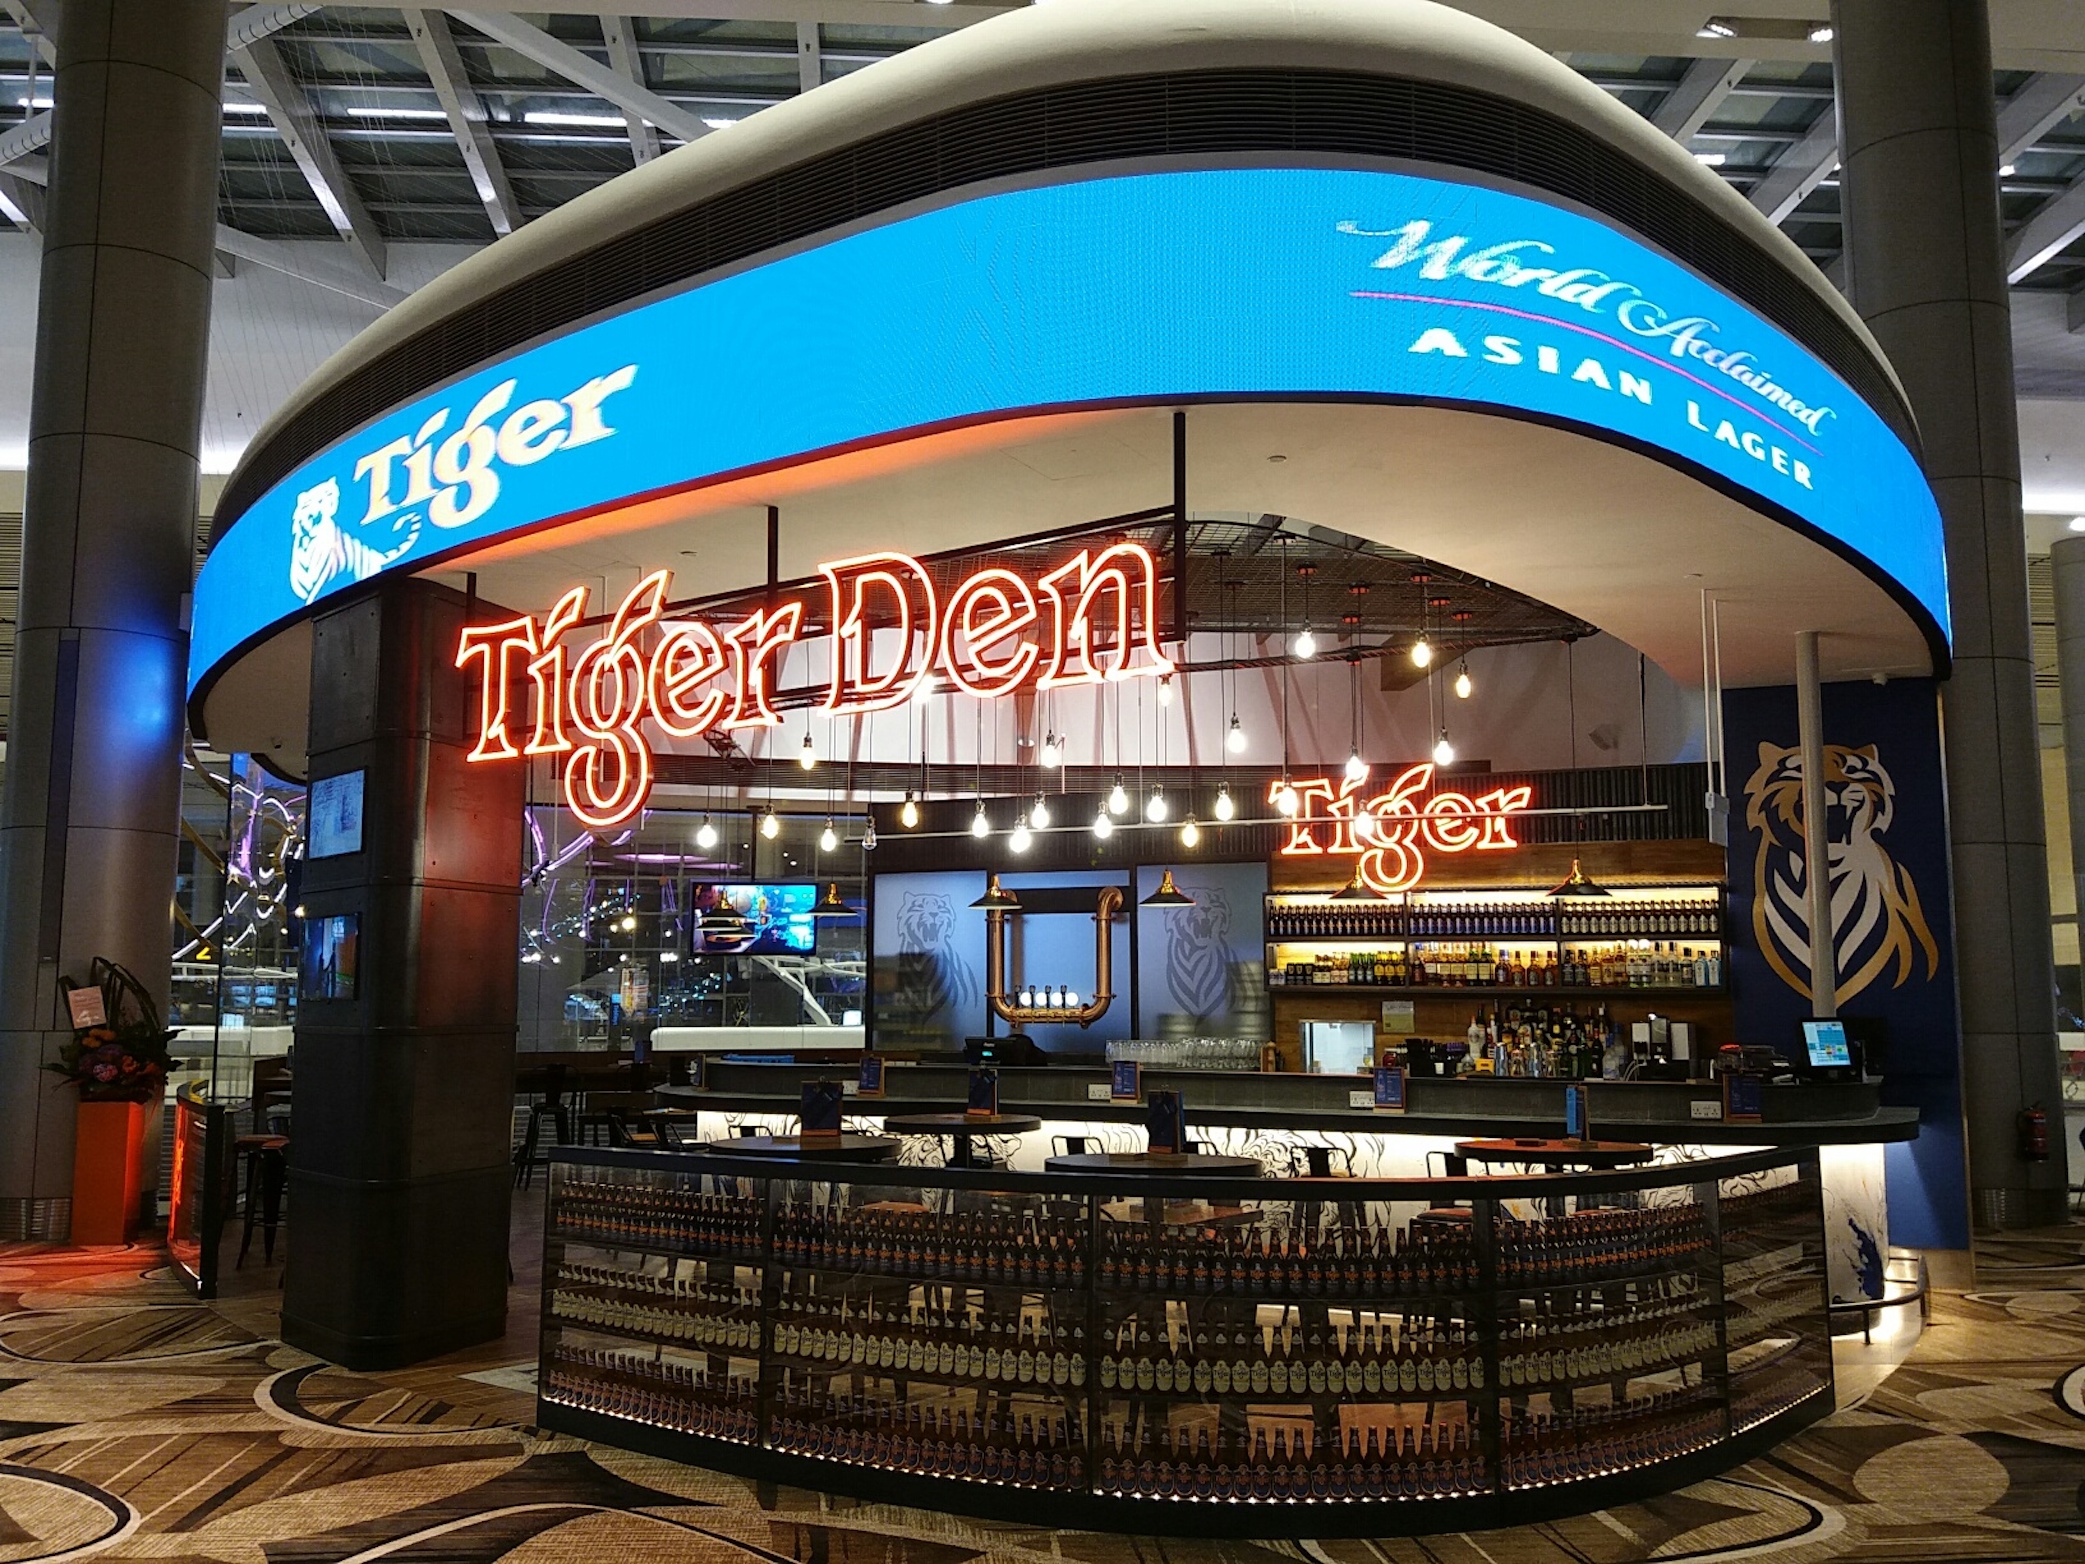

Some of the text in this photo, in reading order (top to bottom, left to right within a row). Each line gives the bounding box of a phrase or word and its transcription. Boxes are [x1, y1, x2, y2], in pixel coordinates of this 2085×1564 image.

[1336, 219, 1837, 437] World Acclaimed
[1408, 327, 1815, 490] ASIAN LAGER
[352, 363, 639, 529] Tiger
[454, 542, 1176, 827] Tiger Den
[1267, 763, 1532, 893] Tiger
